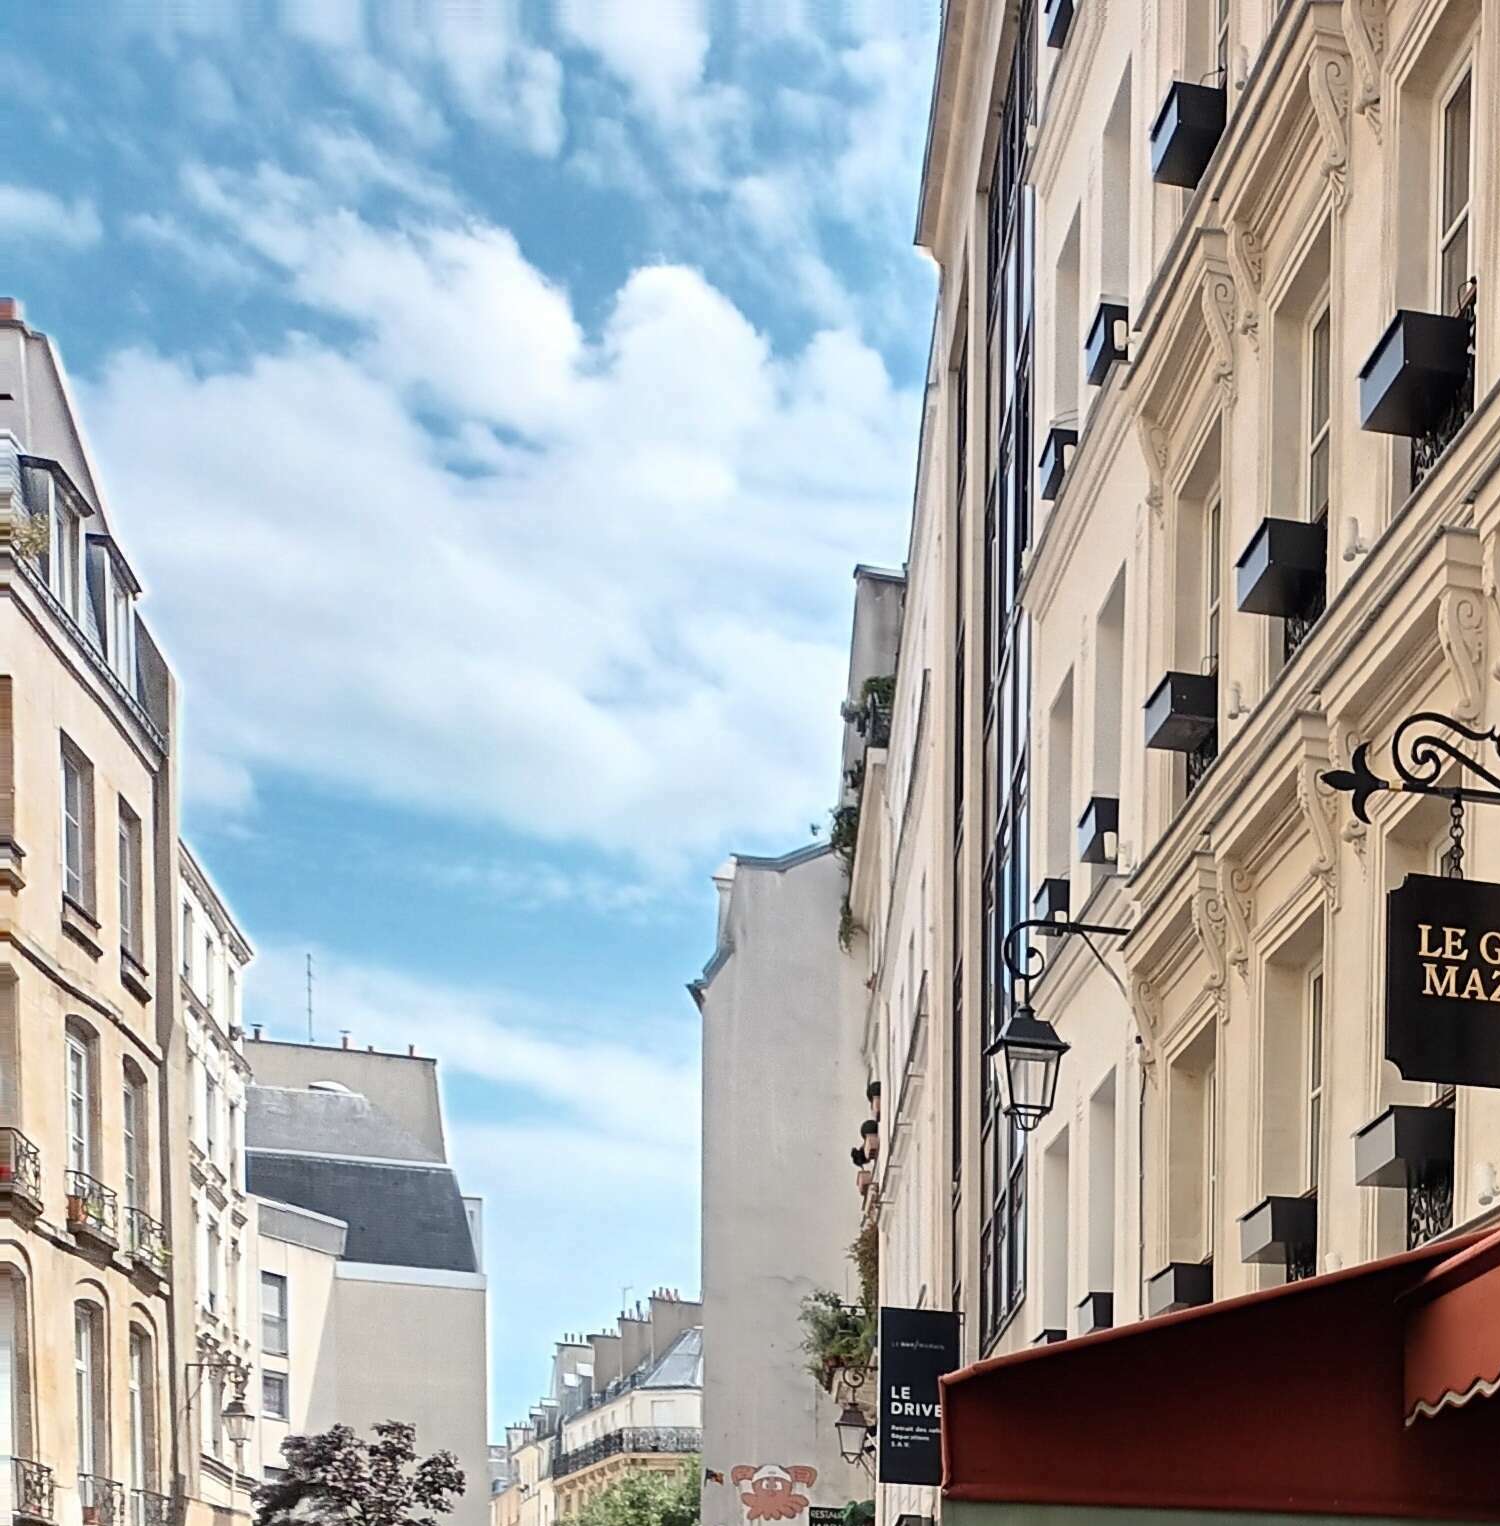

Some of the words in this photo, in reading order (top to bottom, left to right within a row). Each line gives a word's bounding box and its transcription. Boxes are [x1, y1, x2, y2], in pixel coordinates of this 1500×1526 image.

[1417, 923, 1469, 961] LE
[891, 1386, 910, 1399] LE
[891, 1402, 943, 1417] DRIVE
